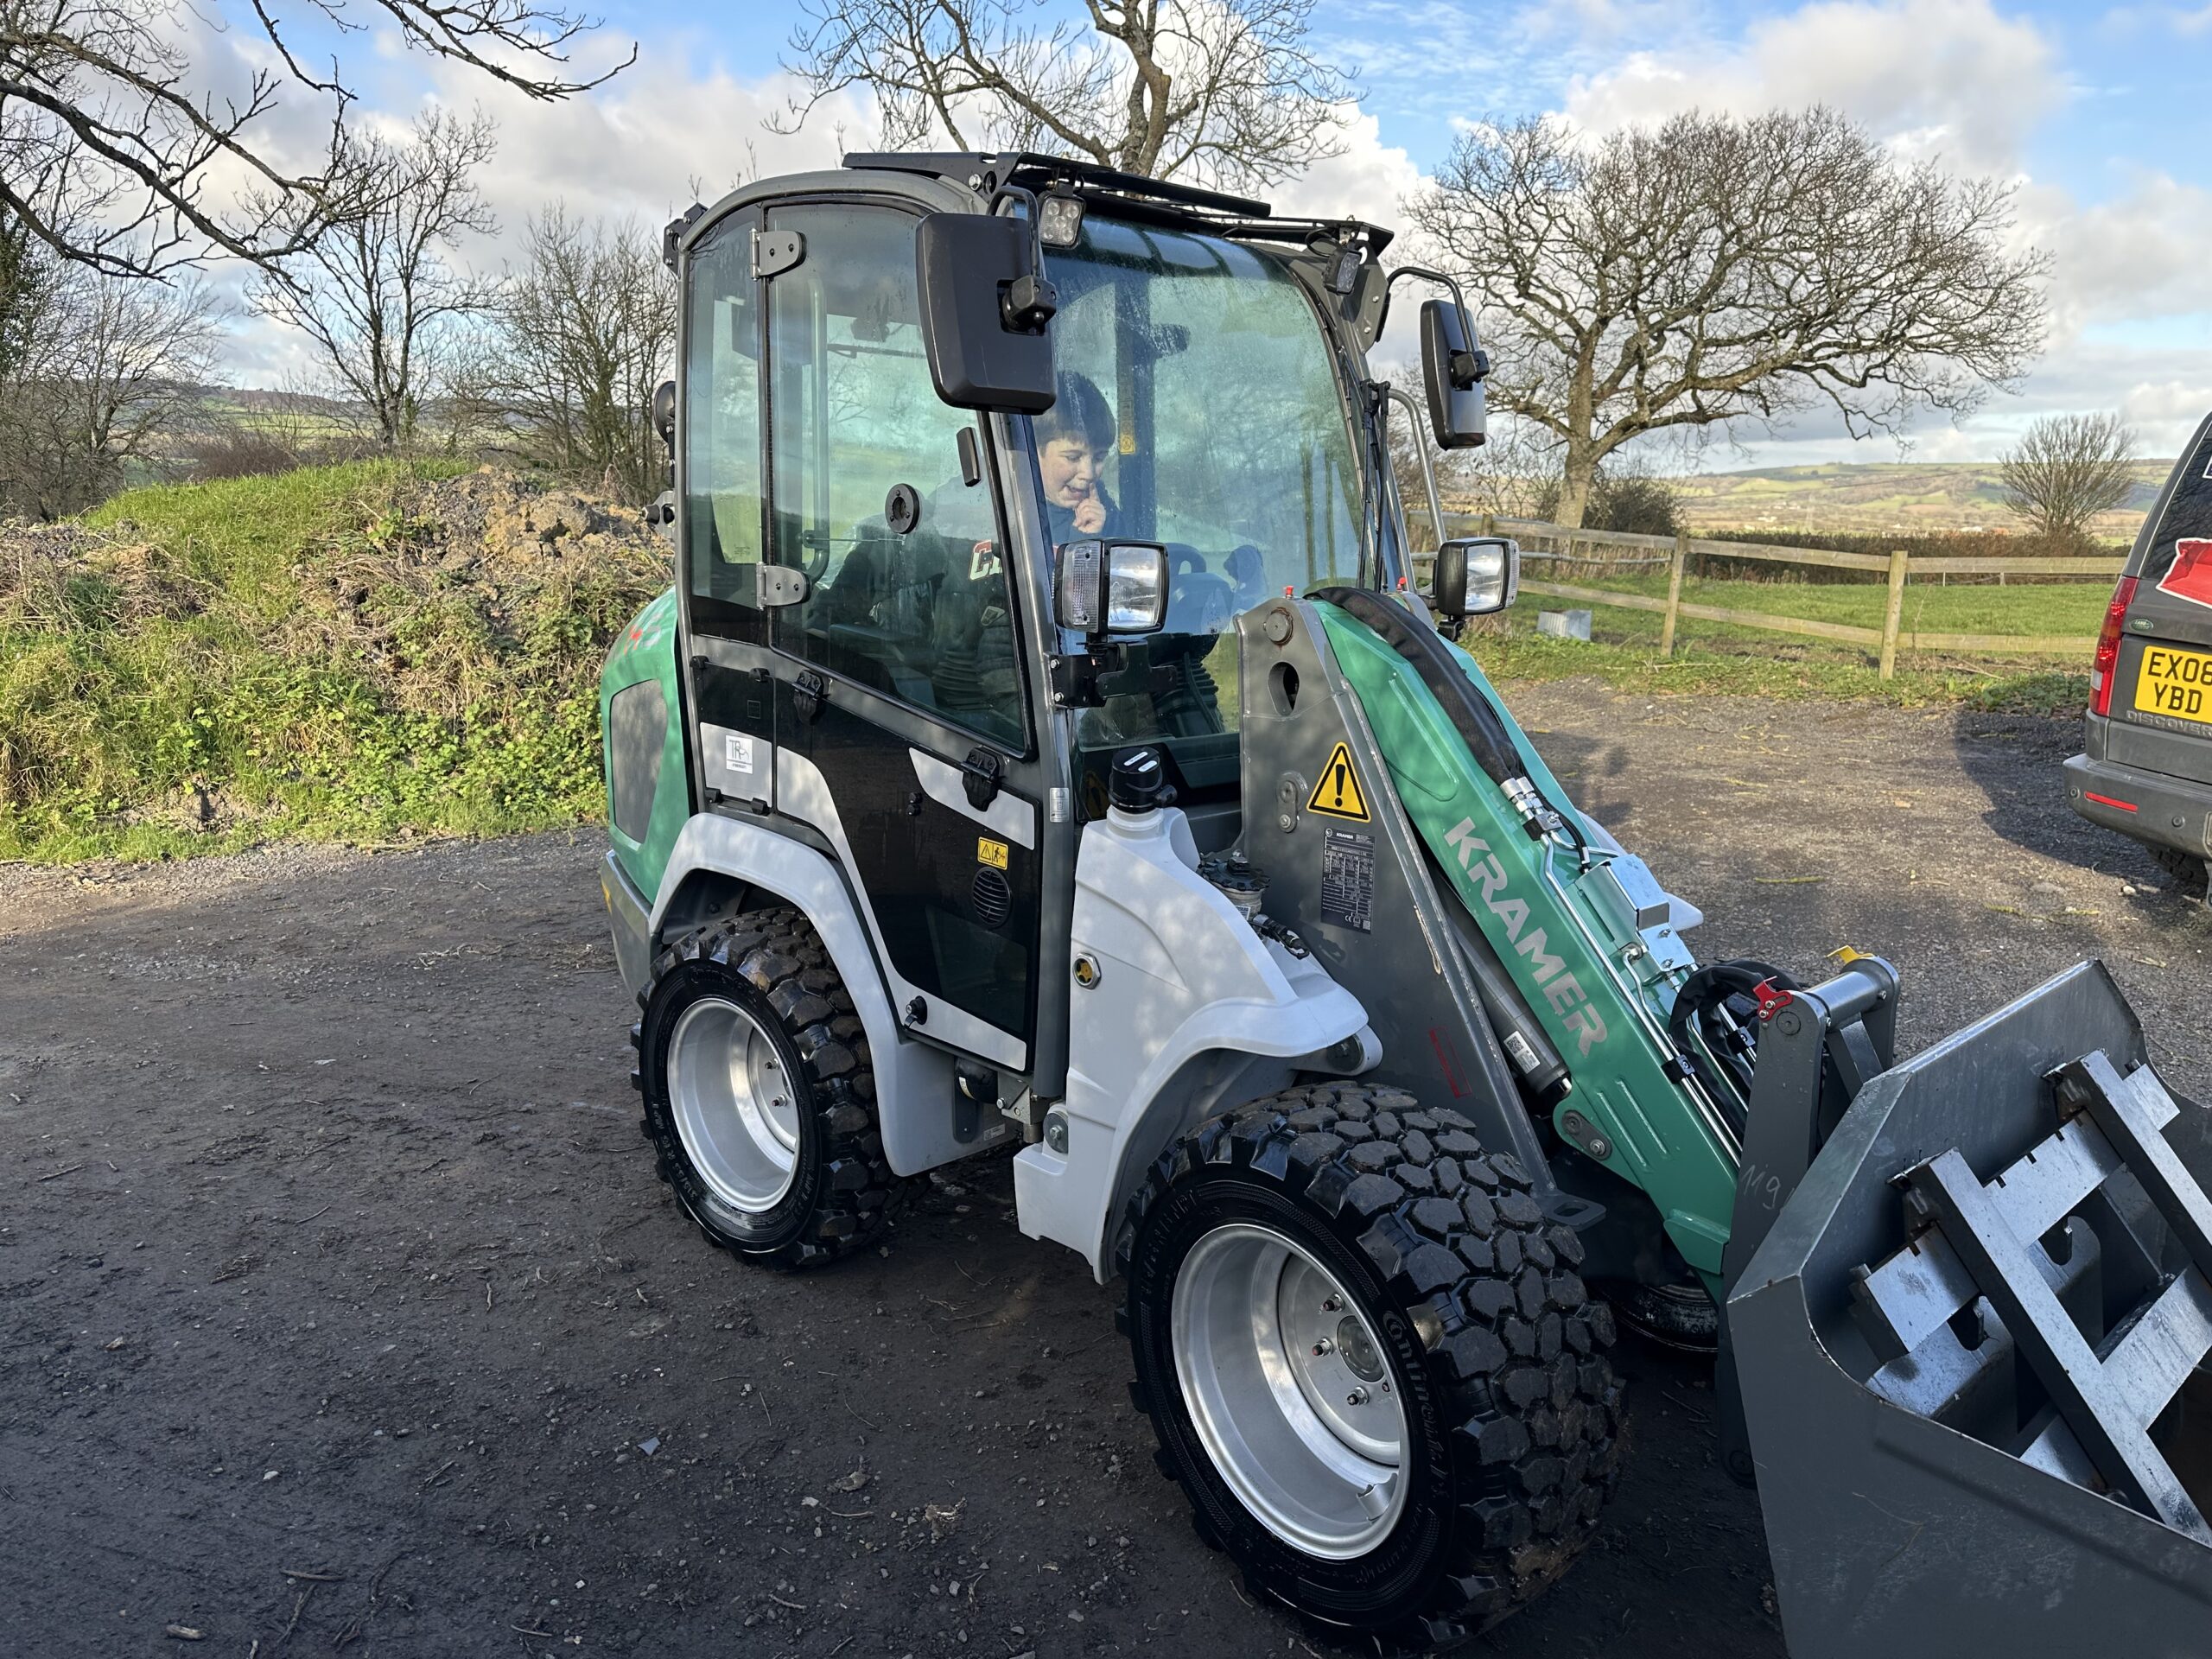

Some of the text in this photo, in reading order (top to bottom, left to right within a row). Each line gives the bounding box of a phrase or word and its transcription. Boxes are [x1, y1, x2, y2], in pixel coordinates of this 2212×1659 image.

[2147, 652, 2212, 686] EX08
[2154, 682, 2203, 715] YBD
[1444, 817, 1607, 1058] KRAMER
